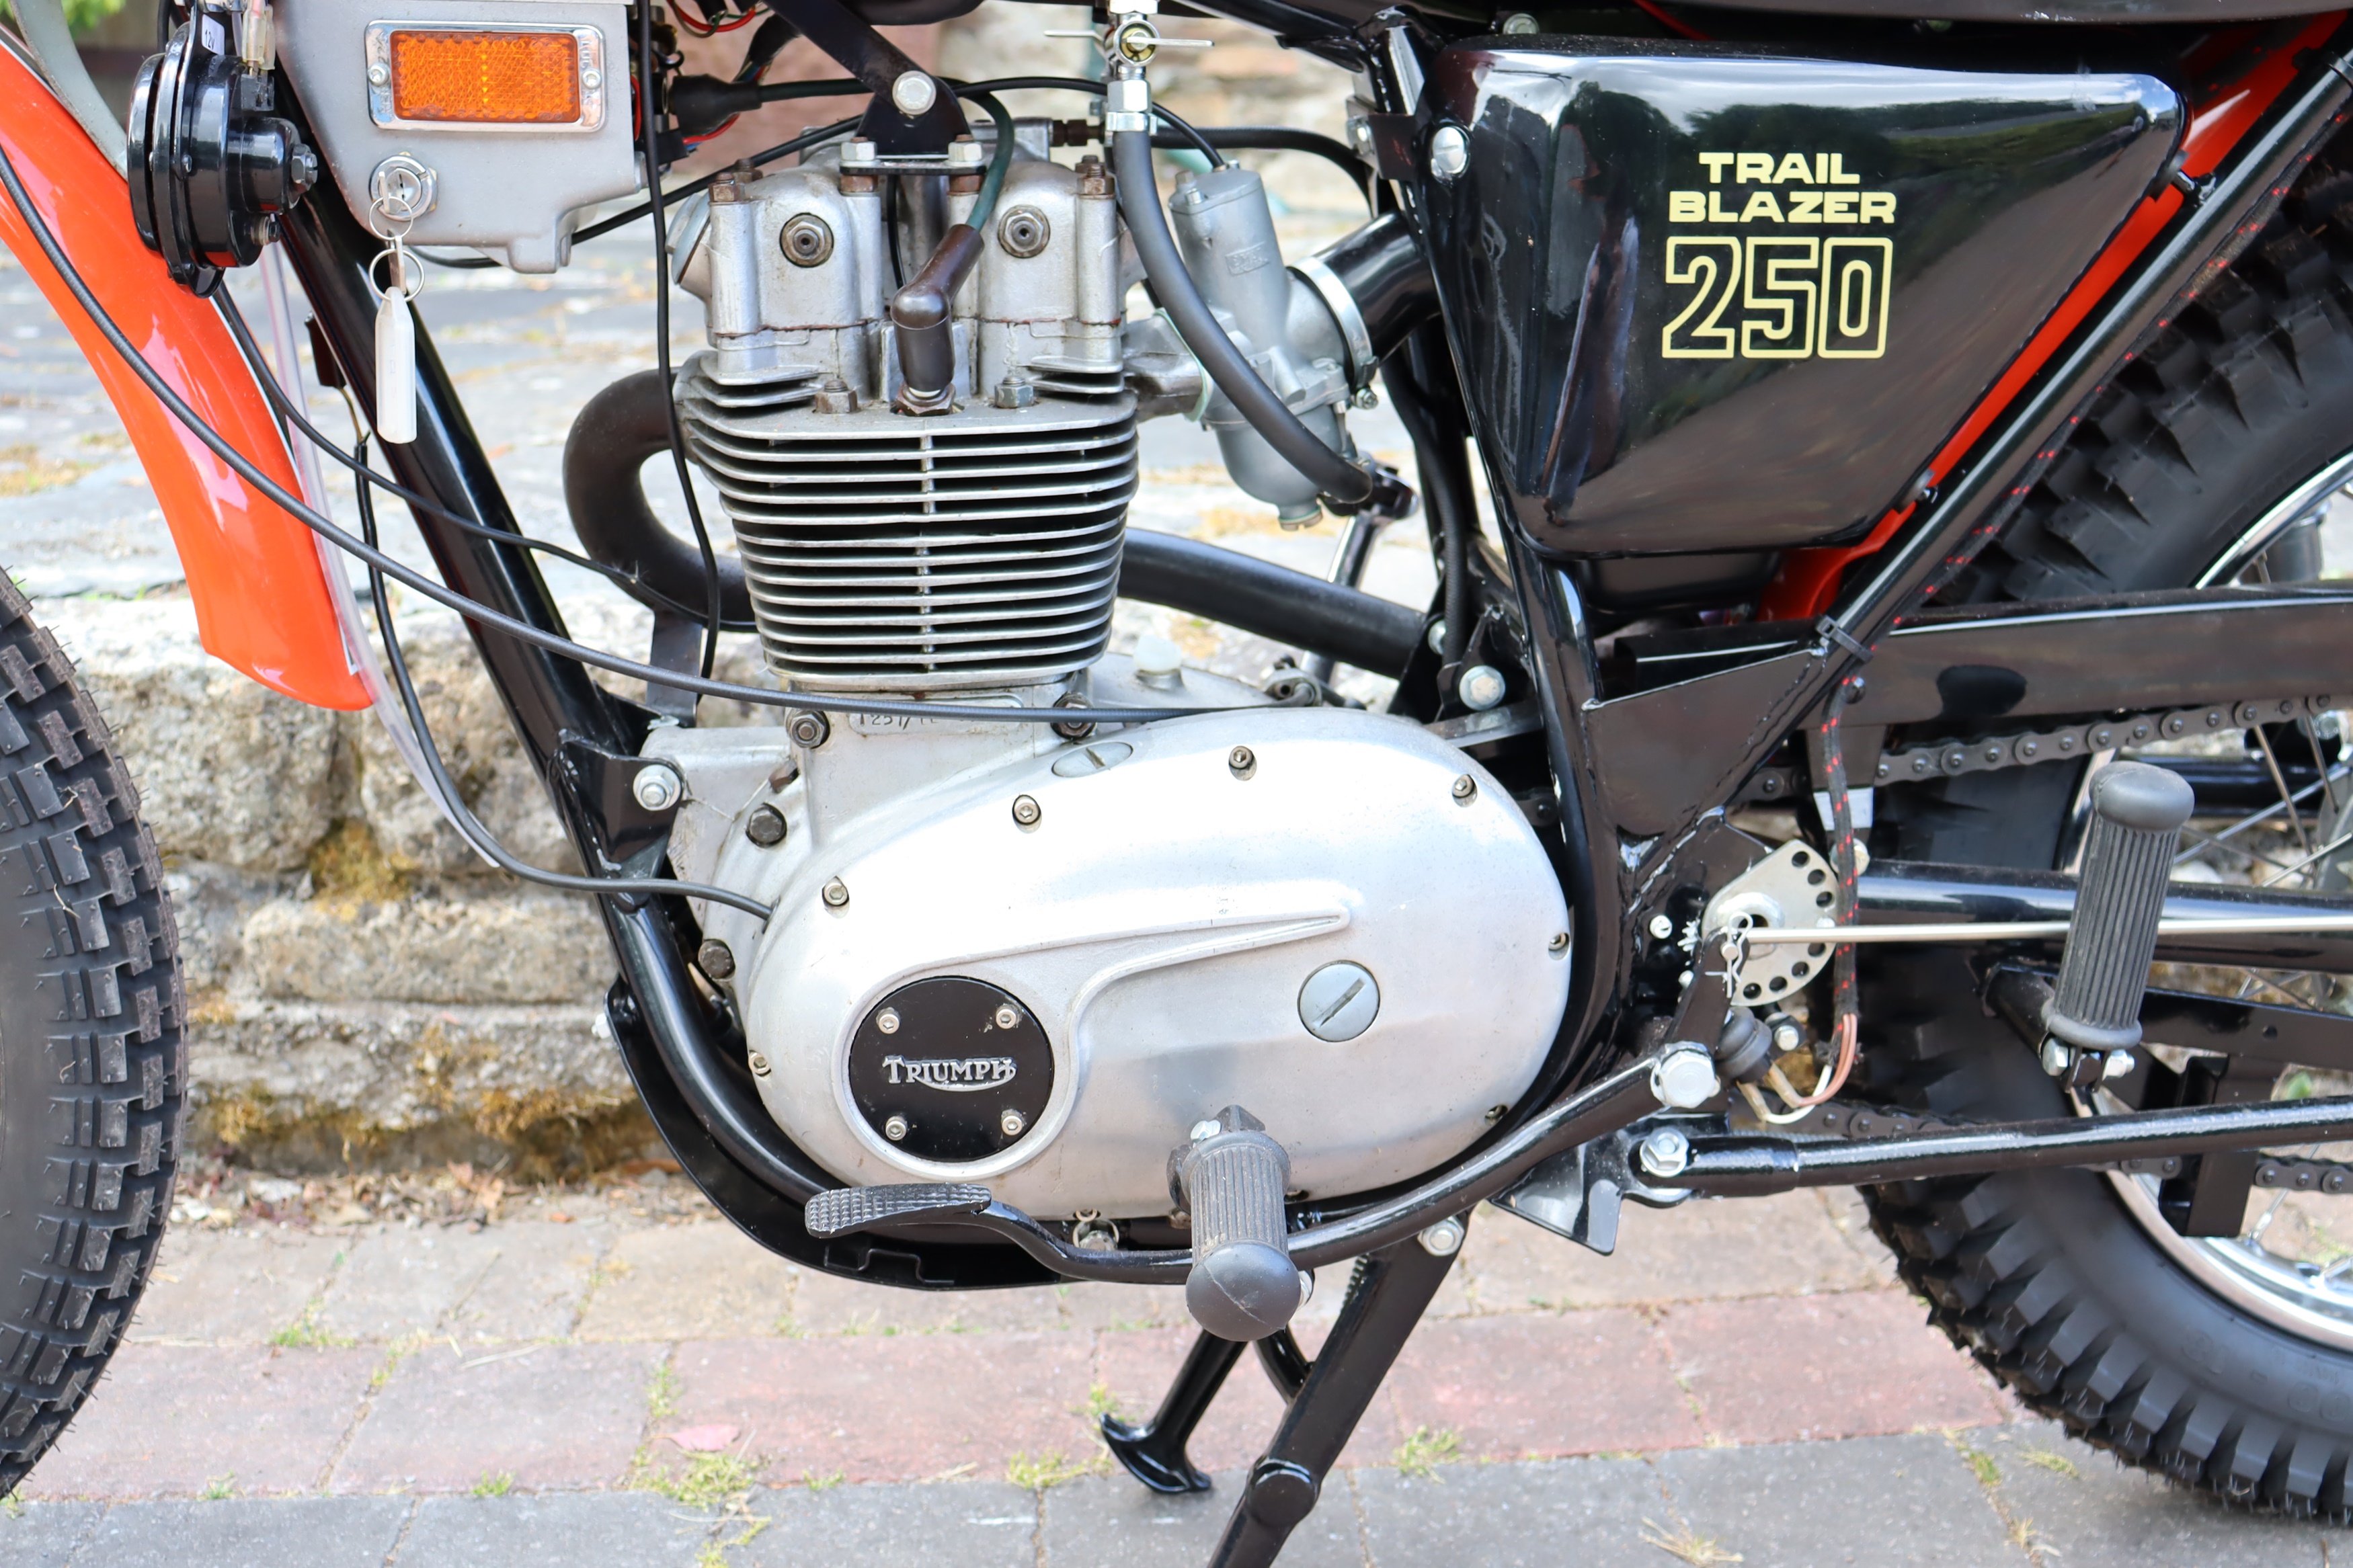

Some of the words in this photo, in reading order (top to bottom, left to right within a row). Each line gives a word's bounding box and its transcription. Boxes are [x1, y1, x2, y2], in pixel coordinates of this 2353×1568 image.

[1699, 153, 1860, 184] TRAIL
[1669, 191, 1897, 223] BLAZER
[1662, 236, 1893, 359] 250
[882, 1055, 1017, 1091] TRIUMPH
